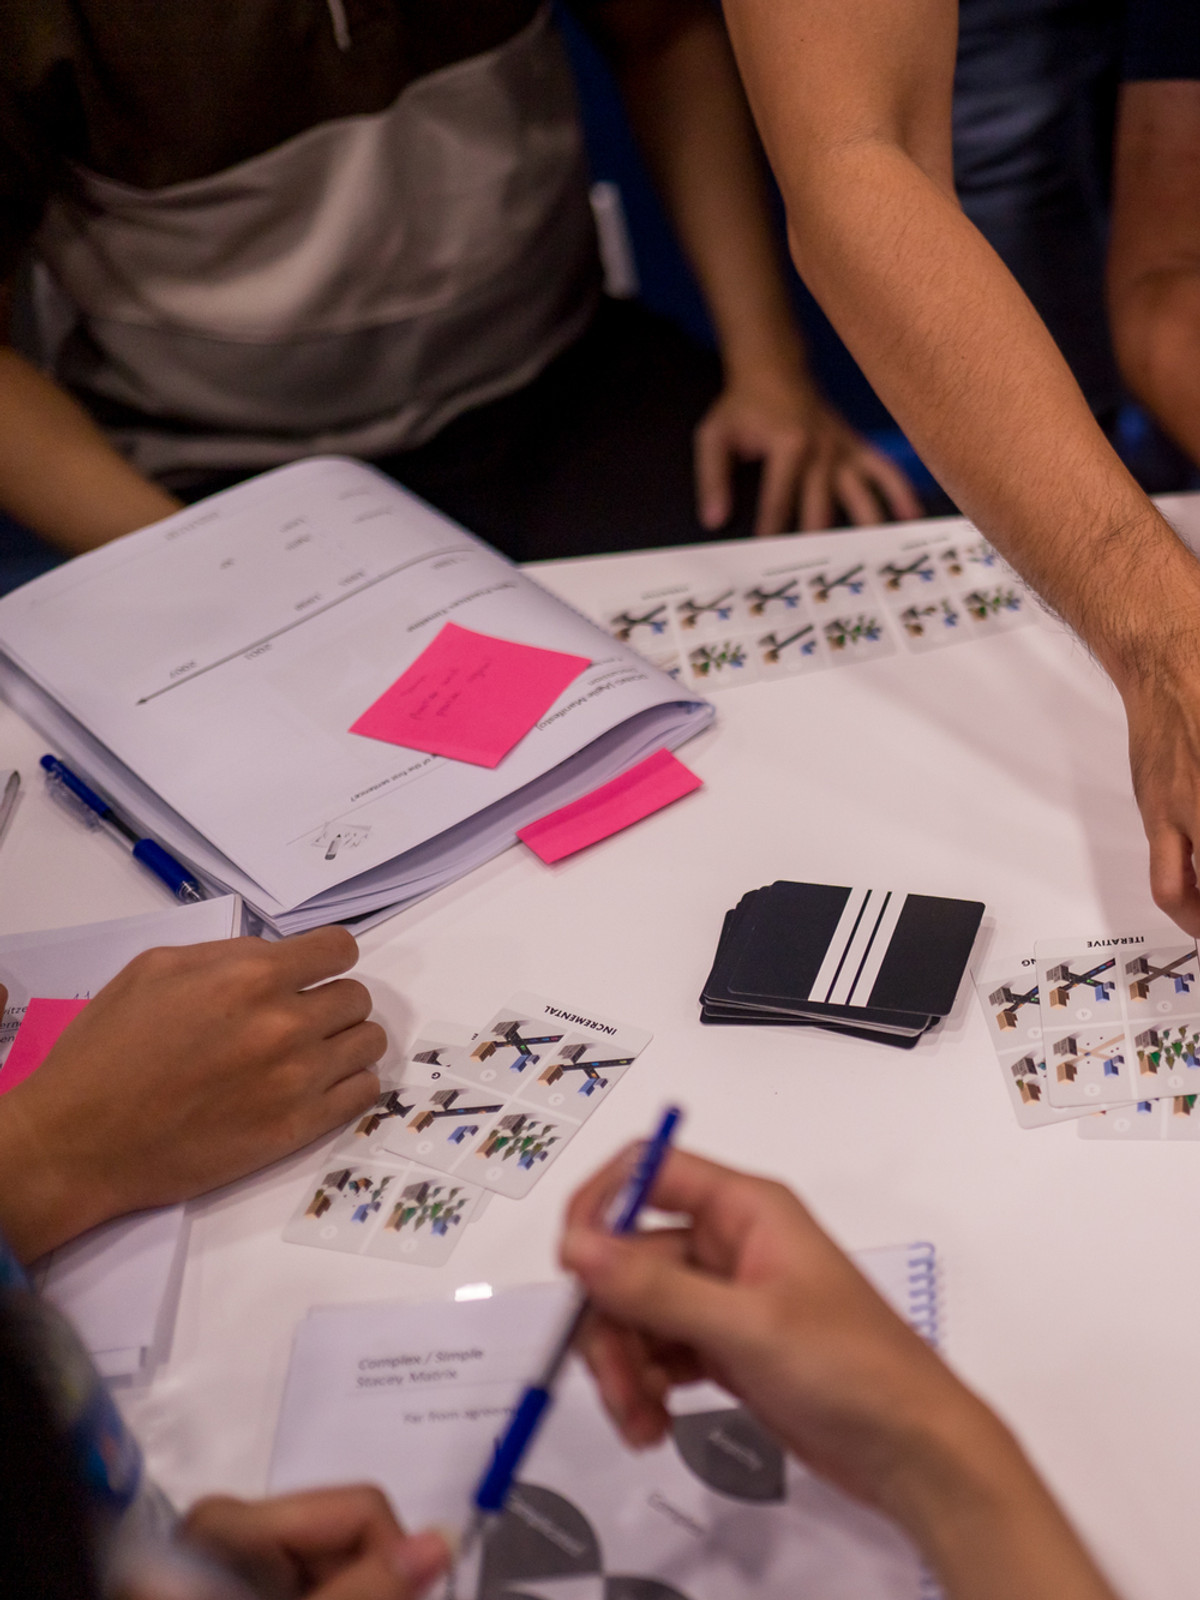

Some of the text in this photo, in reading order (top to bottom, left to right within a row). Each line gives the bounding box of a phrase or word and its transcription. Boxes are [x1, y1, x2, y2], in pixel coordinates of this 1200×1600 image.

[1086, 936, 1145, 948] ITERATIVE
[544, 1004, 619, 1036] INCREMENTAL
[358, 1355, 422, 1371] Complex
[434, 1349, 484, 1363] Simple
